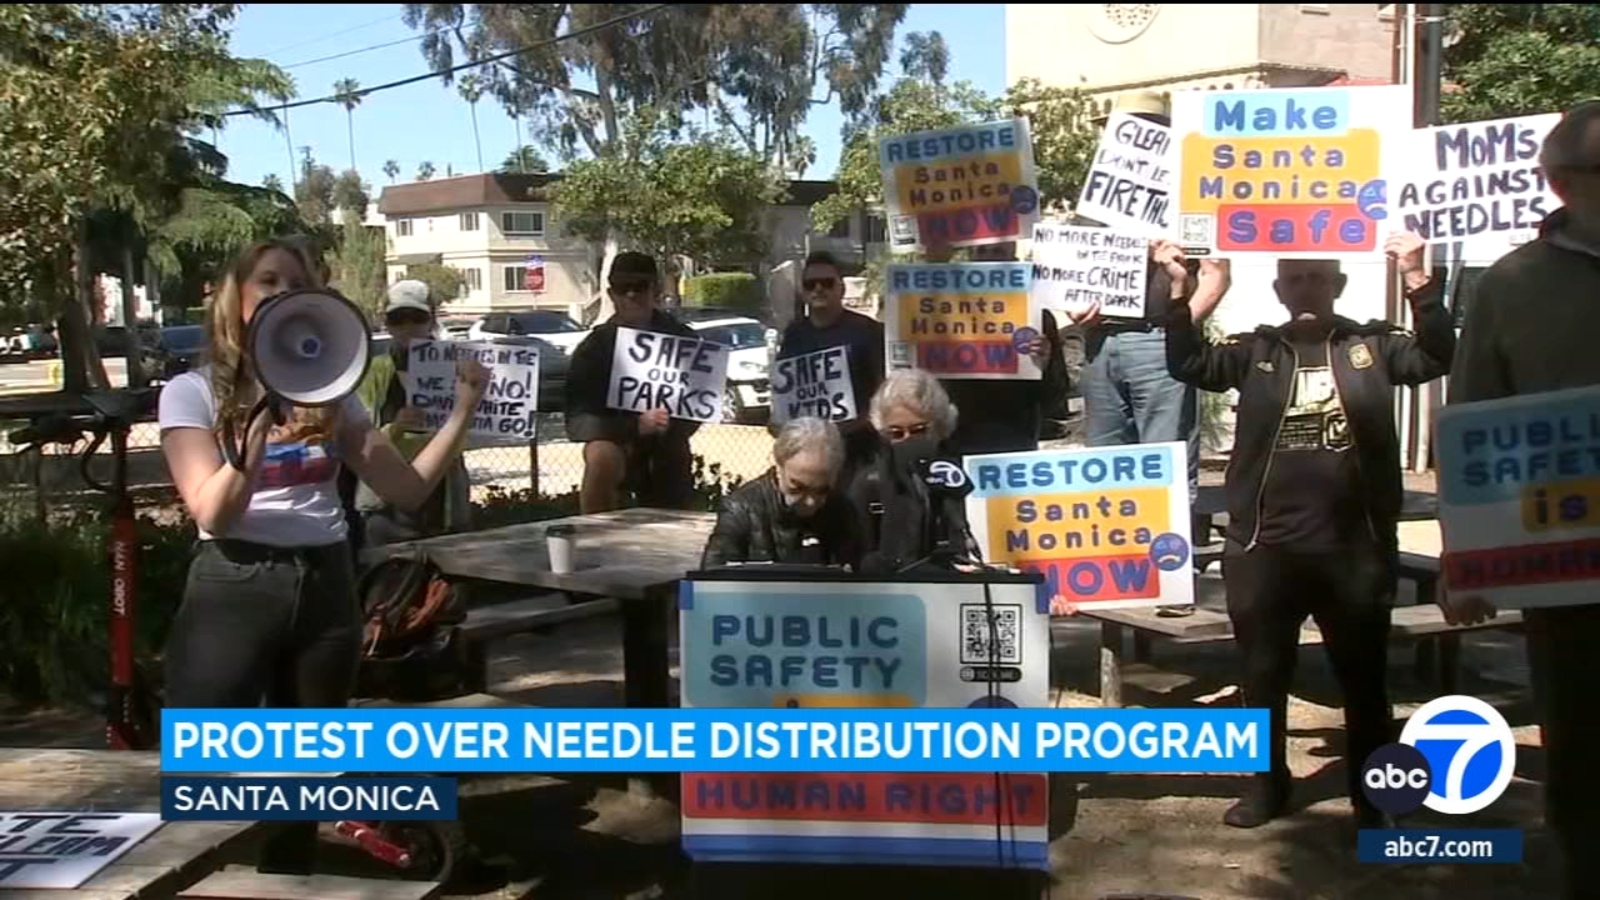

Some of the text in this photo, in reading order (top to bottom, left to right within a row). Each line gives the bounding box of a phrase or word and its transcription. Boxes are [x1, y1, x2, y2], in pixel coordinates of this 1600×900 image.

[1214, 98, 1337, 132] Make
[887, 127, 1014, 162] RESTORE
[1213, 144, 1344, 170] Santa
[915, 160, 998, 183] Santa
[909, 182, 1012, 208] Monica
[1199, 174, 1358, 201] Monica
[1398, 166, 1546, 208] AGAINST
[1227, 209, 1366, 246] Safe
[1403, 196, 1548, 241] NEEDLES
[1035, 228, 1054, 243] NO
[1058, 230, 1102, 247] MORE
[893, 269, 1026, 290] RESTORE
[1031, 264, 1143, 291] NO MORE CRIME
[919, 297, 1006, 315] Santa
[1105, 293, 1142, 309] DARK
[910, 317, 1016, 335] Monica
[628, 333, 722, 374] SAFE
[489, 371, 532, 400] NO!
[647, 368, 691, 387] OUR
[773, 349, 842, 395] SAFE
[617, 376, 718, 419] PARKS
[796, 381, 829, 400] OUR
[498, 410, 534, 438] GO!
[977, 453, 1164, 491] RESTORE
[1015, 496, 1138, 523] Santa
[1533, 488, 1588, 525] is
[1005, 524, 1152, 553] Monica
[712, 614, 900, 649] PUBLIC
[710, 655, 901, 688] SAFETY
[696, 778, 1036, 818] HUMAN RIGHT
